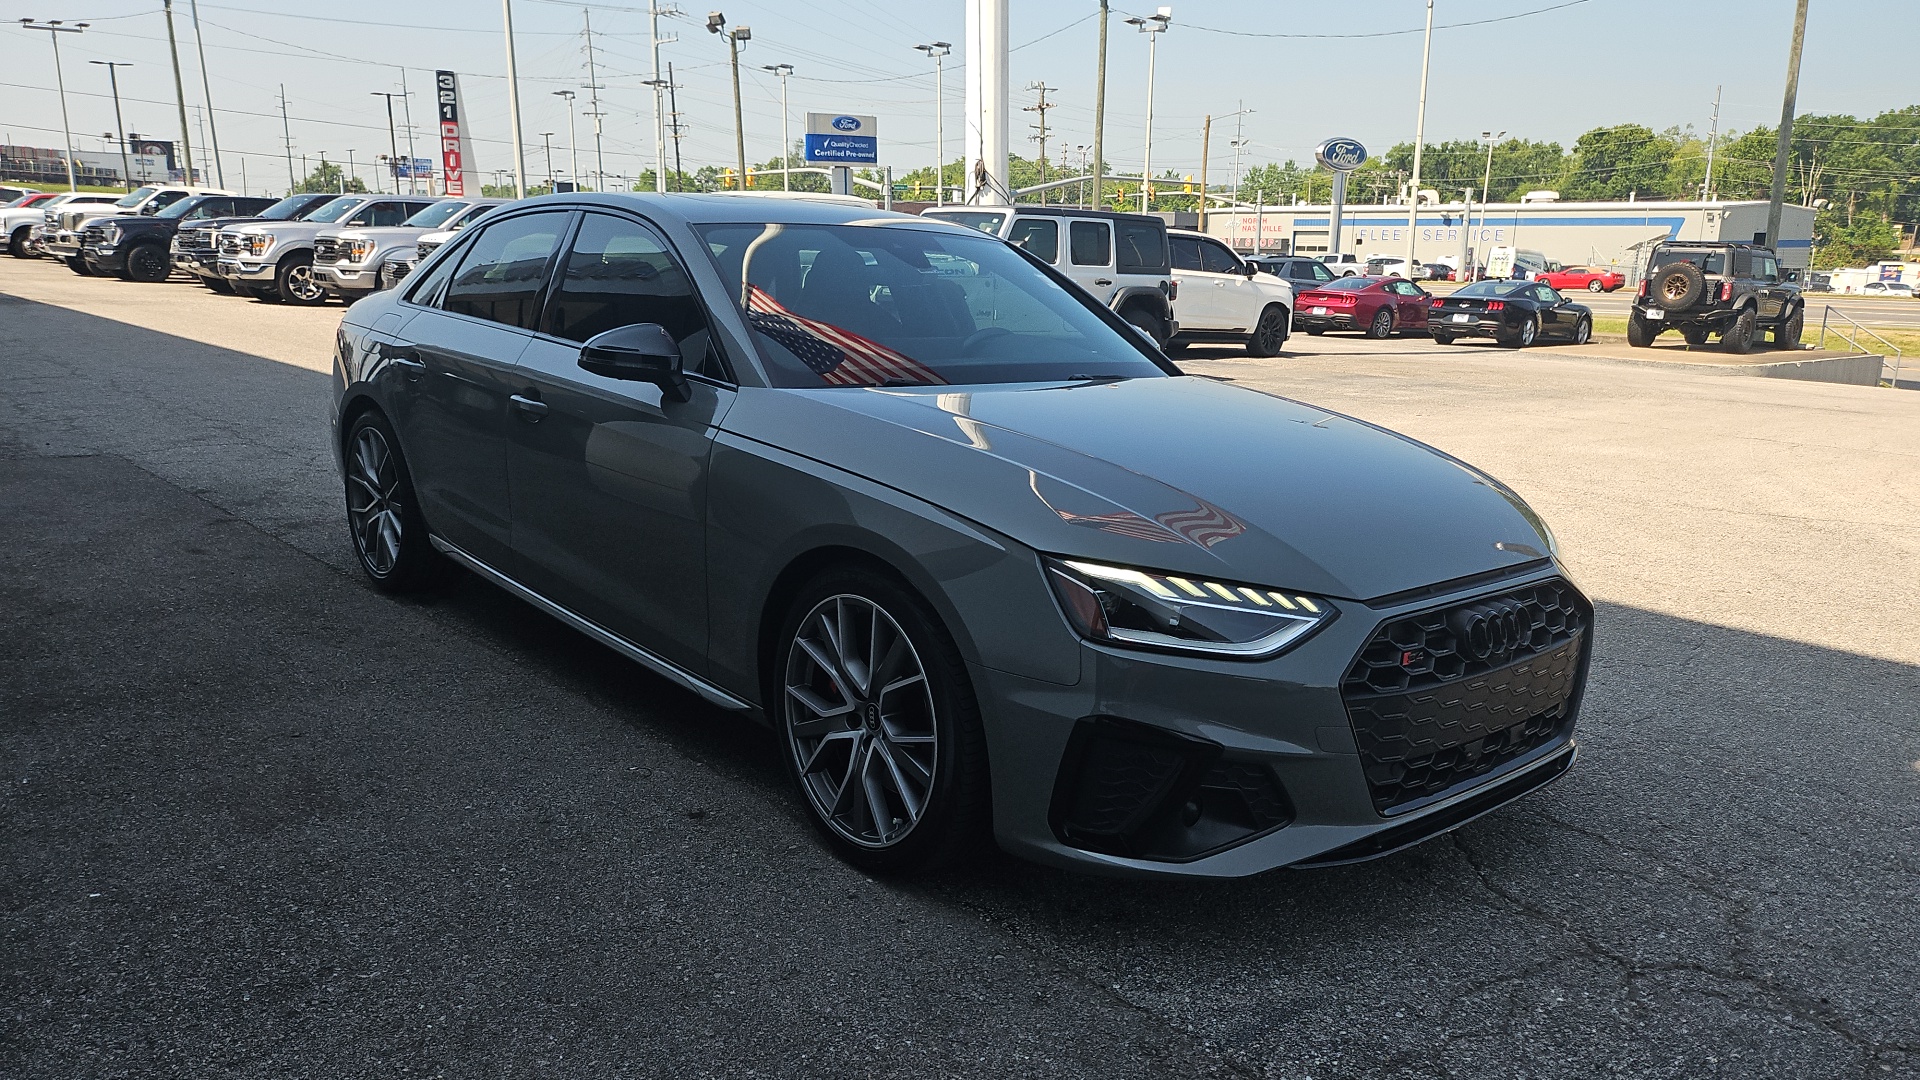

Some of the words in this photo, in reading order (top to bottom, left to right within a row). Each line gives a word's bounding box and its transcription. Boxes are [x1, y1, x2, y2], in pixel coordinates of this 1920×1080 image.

[439, 75, 456, 119] 321
[840, 119, 857, 129] Ford
[831, 141, 869, 149] QualityChecked
[442, 124, 463, 194] DRIVE
[814, 149, 845, 157] Certified
[846, 150, 875, 158] Pre-owned
[1332, 143, 1361, 165] Ford
[1242, 217, 1268, 225] NORH
[1423, 229, 1504, 241] SERICE
